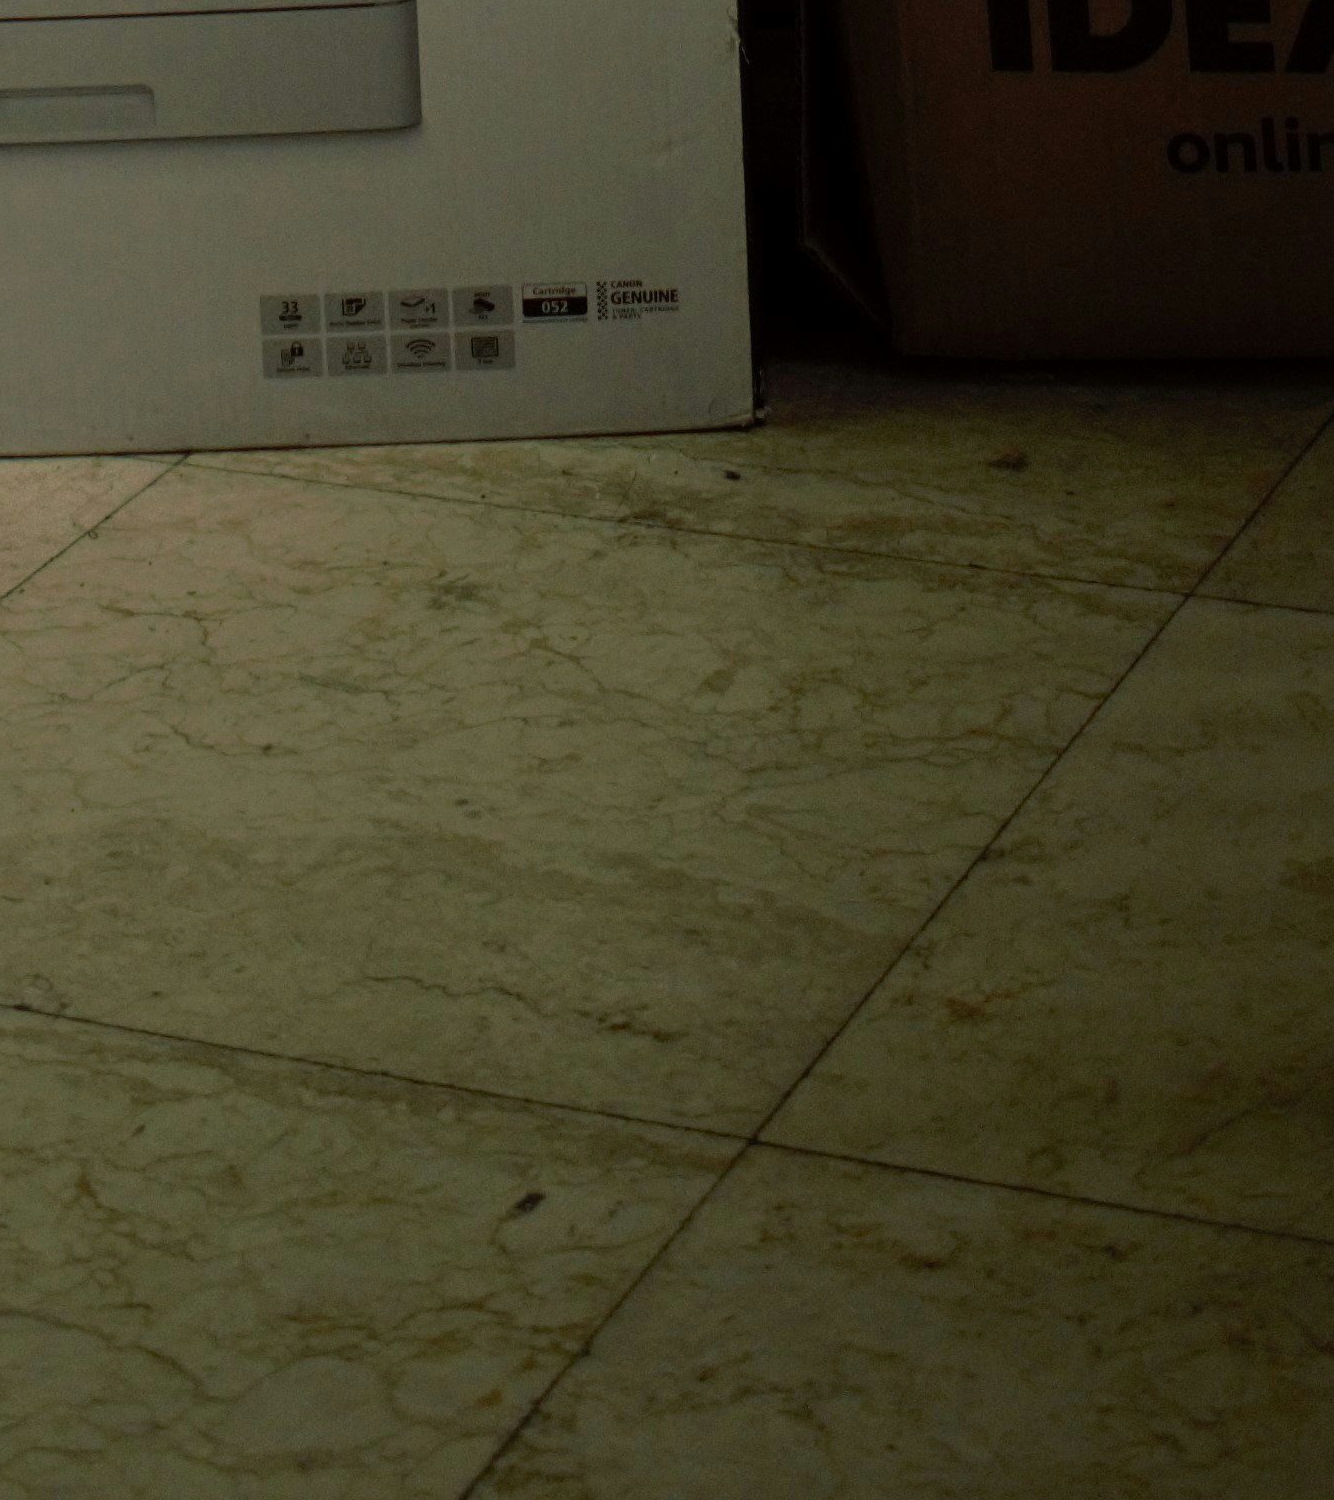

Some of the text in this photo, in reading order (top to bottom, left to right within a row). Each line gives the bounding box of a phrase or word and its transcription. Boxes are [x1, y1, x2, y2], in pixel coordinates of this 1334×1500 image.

[532, 286, 577, 296] Cartridge
[610, 289, 679, 305] GENUINE
[282, 301, 299, 314] 33
[541, 300, 569, 314] 052
